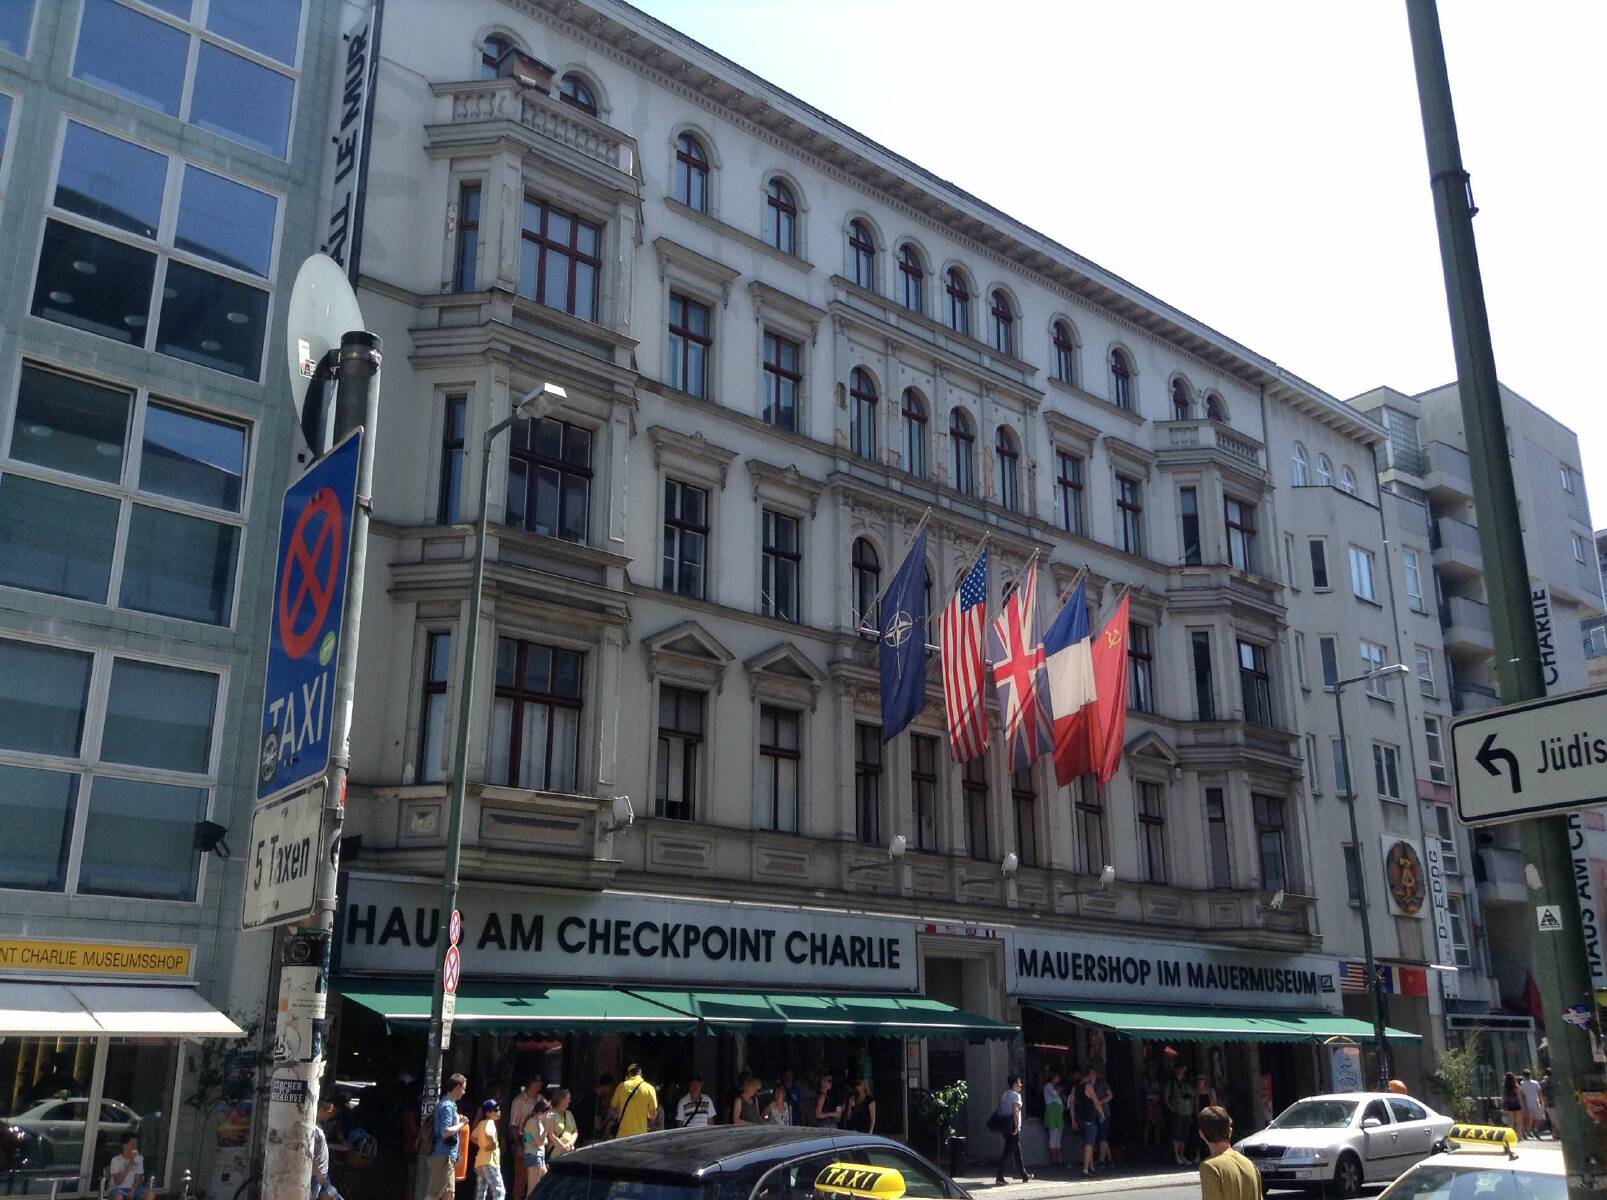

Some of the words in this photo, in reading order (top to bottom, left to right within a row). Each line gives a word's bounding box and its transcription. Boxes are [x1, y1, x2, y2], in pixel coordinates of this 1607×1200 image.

[329, 191, 352, 268] ALL
[341, 24, 368, 131] MUR
[1533, 589, 1558, 686] CHARLIE
[269, 672, 328, 761] TAXI
[1537, 732, 1607, 774] Jüdis
[254, 840, 265, 891] 5
[269, 834, 310, 887] Taxen
[1429, 850, 1447, 939] D-EDDG
[21, 948, 77, 965] CHARLIE
[83, 951, 183, 970] MUSEUMSSHOP
[347, 903, 465, 948] HAU
[477, 912, 544, 952] AM
[557, 916, 776, 963] CHECKPOINT
[785, 930, 900, 969] CHARLIE
[1018, 948, 1151, 986] MAUERSHOP
[1158, 959, 1181, 988] IM
[1187, 961, 1317, 995] MAUERMUSEUM
[1457, 1127, 1499, 1140] TAXI
[825, 1167, 874, 1189] TAXI
